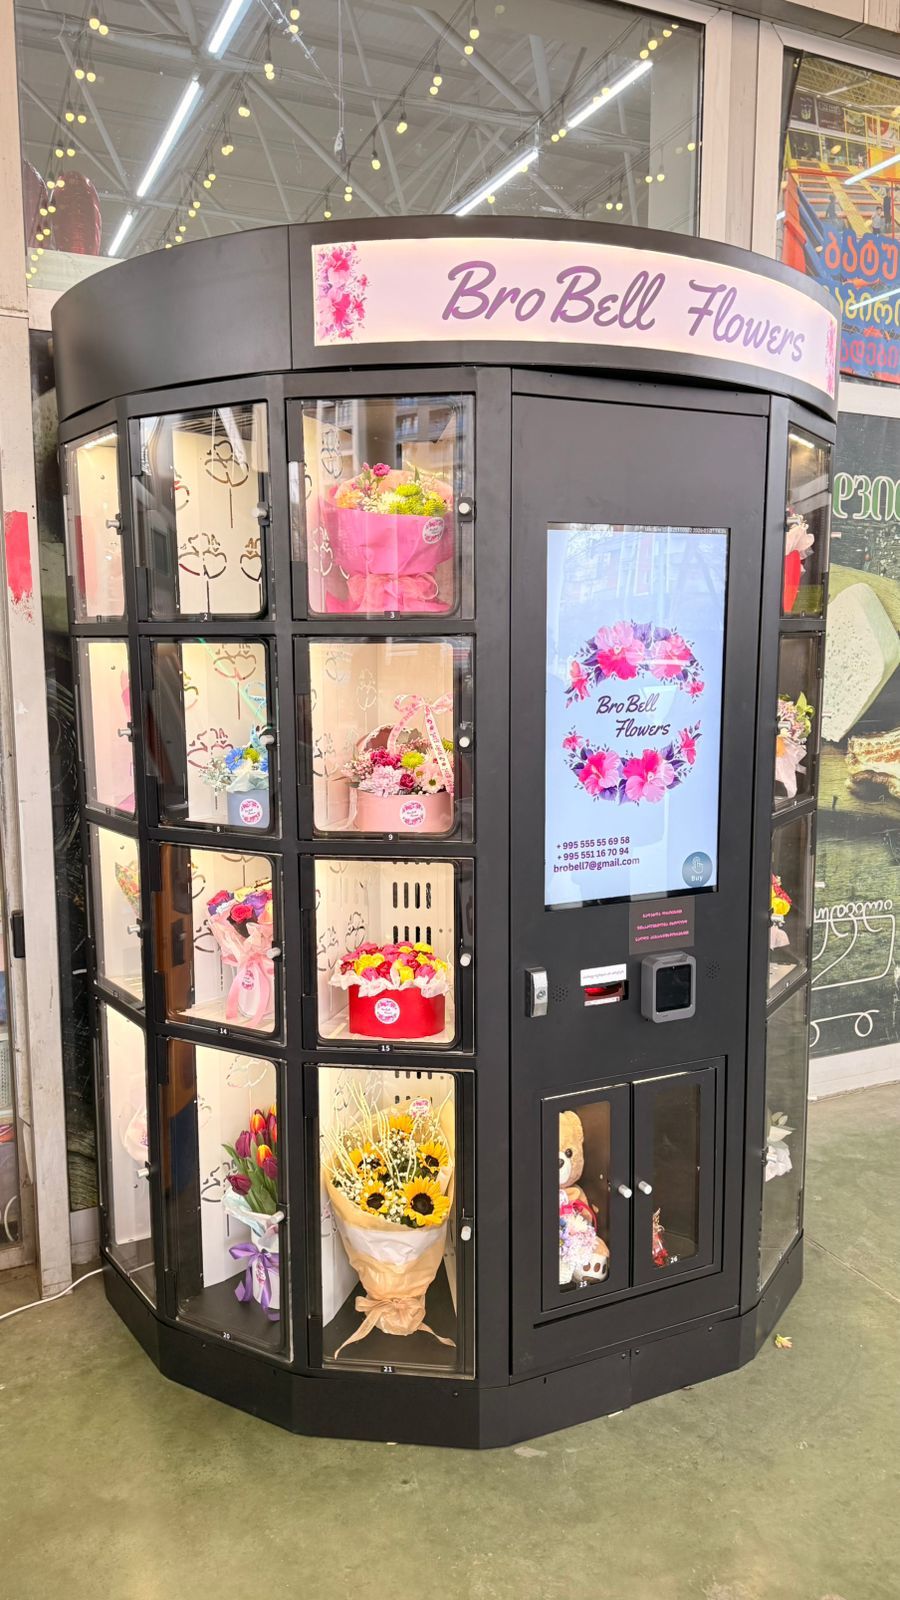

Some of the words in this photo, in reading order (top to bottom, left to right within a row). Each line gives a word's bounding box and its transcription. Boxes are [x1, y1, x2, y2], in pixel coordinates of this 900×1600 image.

[687, 279, 806, 363] Flowers
[615, 718, 671, 738] Flowers
[562, 841, 578, 850] 995
[580, 839, 595, 848] 555
[596, 838, 607, 847] 55
[608, 837, 618, 845] 69
[620, 836, 630, 845] 58
[563, 852, 579, 861] 995
[580, 850, 595, 859] 551
[596, 849, 606, 858] 16
[607, 848, 617, 856] 70
[619, 847, 629, 855] 94
[553, 857, 640, 873] brobell7@gmail.com
[219, 1027, 228, 1035] 14
